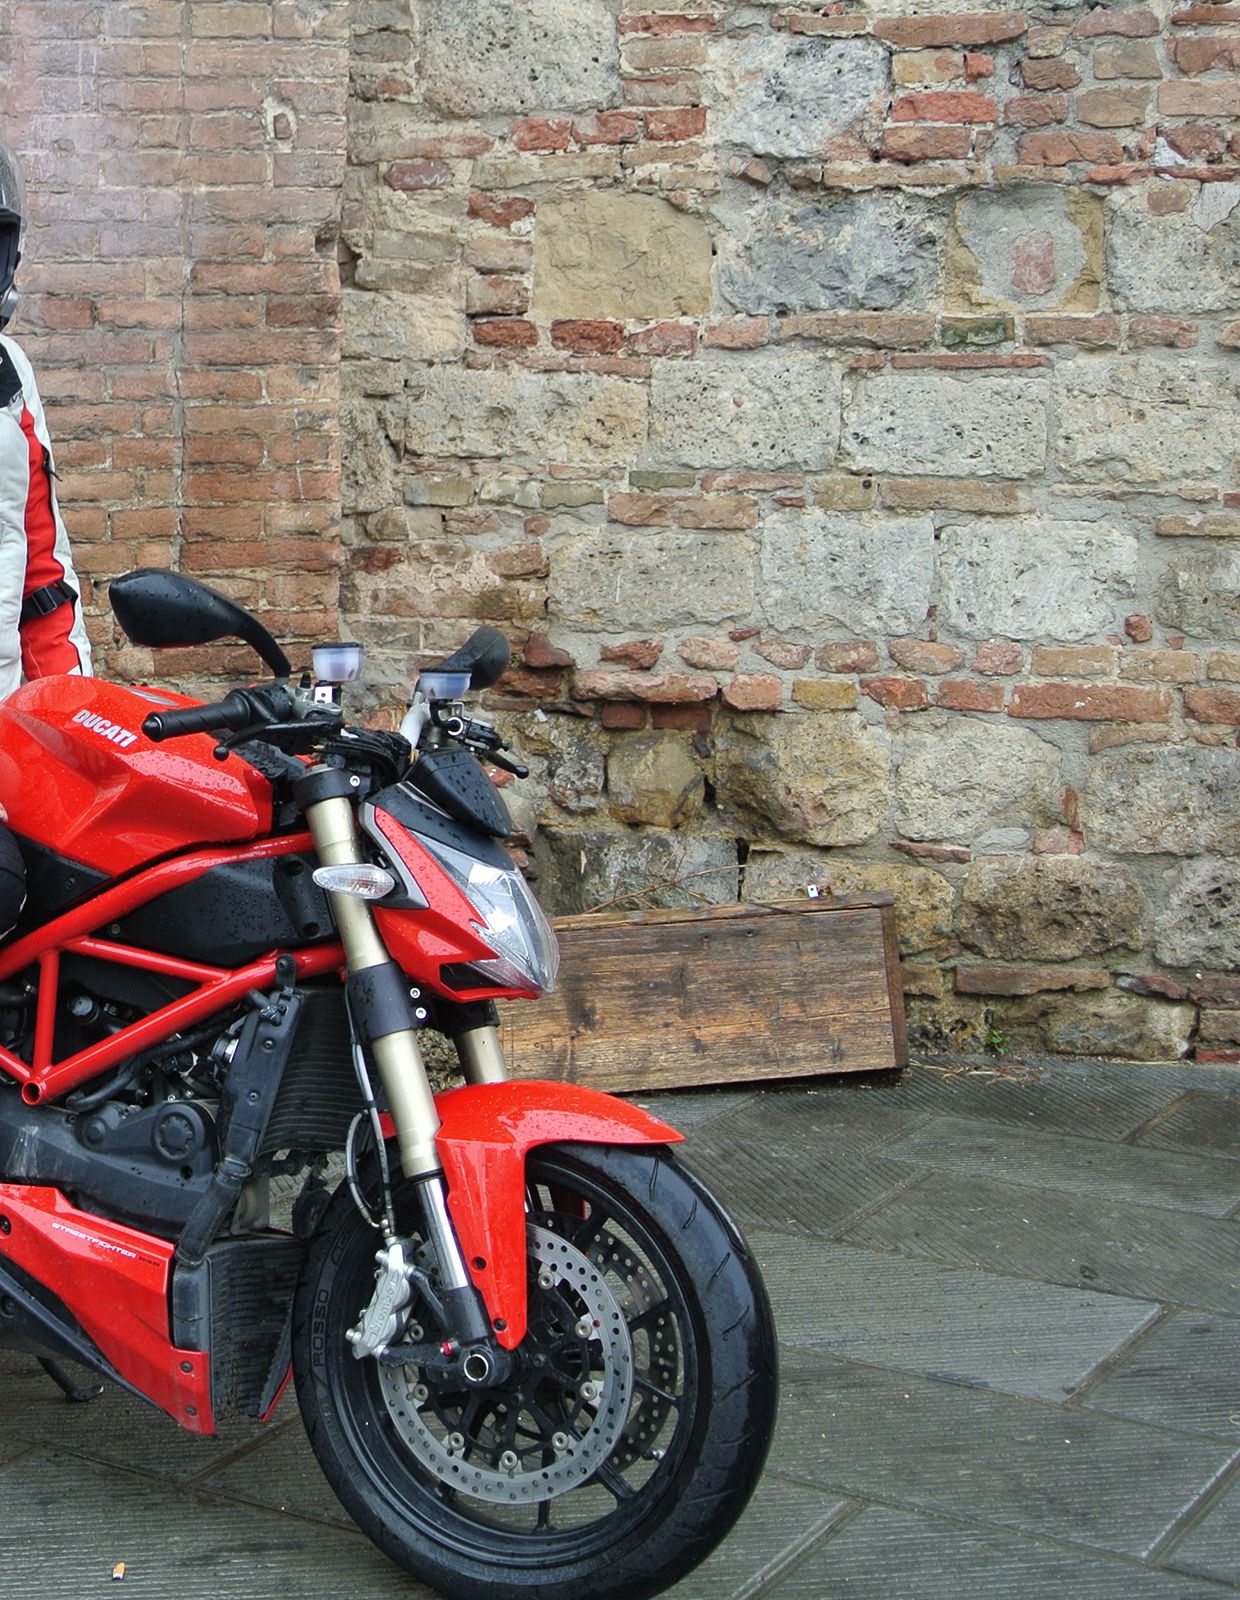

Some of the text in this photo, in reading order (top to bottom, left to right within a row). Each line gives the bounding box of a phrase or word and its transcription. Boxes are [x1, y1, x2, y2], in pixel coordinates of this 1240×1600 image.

[71, 709, 138, 748] DUCATI
[51, 1221, 137, 1259] STREETFIGHTER
[312, 1288, 330, 1367] ROSSO
